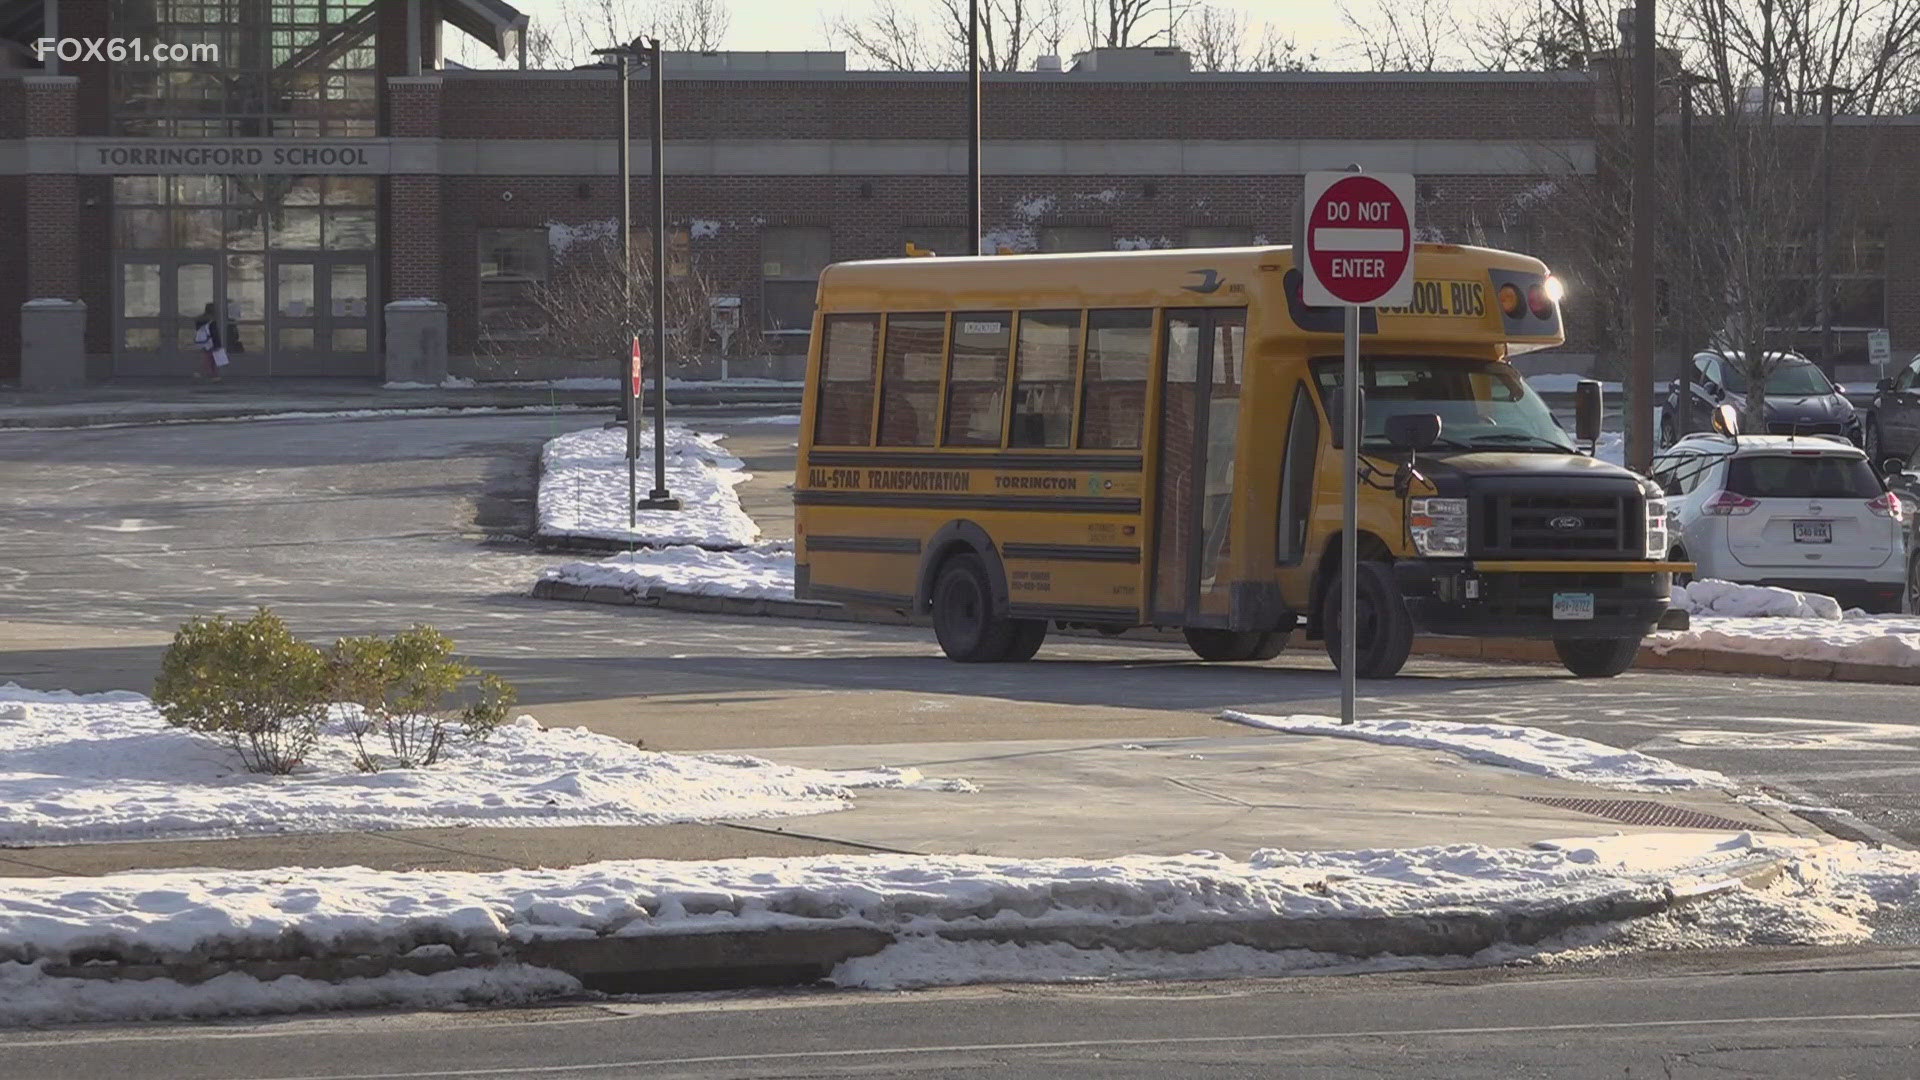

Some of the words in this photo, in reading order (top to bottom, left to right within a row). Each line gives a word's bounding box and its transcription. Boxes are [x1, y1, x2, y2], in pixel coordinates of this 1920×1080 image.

[98, 148, 262, 166] TORRINGFORD
[274, 148, 368, 166] SCHOOL
[1327, 201, 1350, 221] DO
[1358, 201, 1391, 221] NOT
[1331, 258, 1385, 278] ENTER
[1378, 281, 1449, 315] OOL
[1450, 281, 1484, 317] BUS
[808, 468, 861, 489] ALL-STAR
[867, 470, 970, 491] TRANSPORTATION
[994, 476, 1077, 490] TORRINGTON
